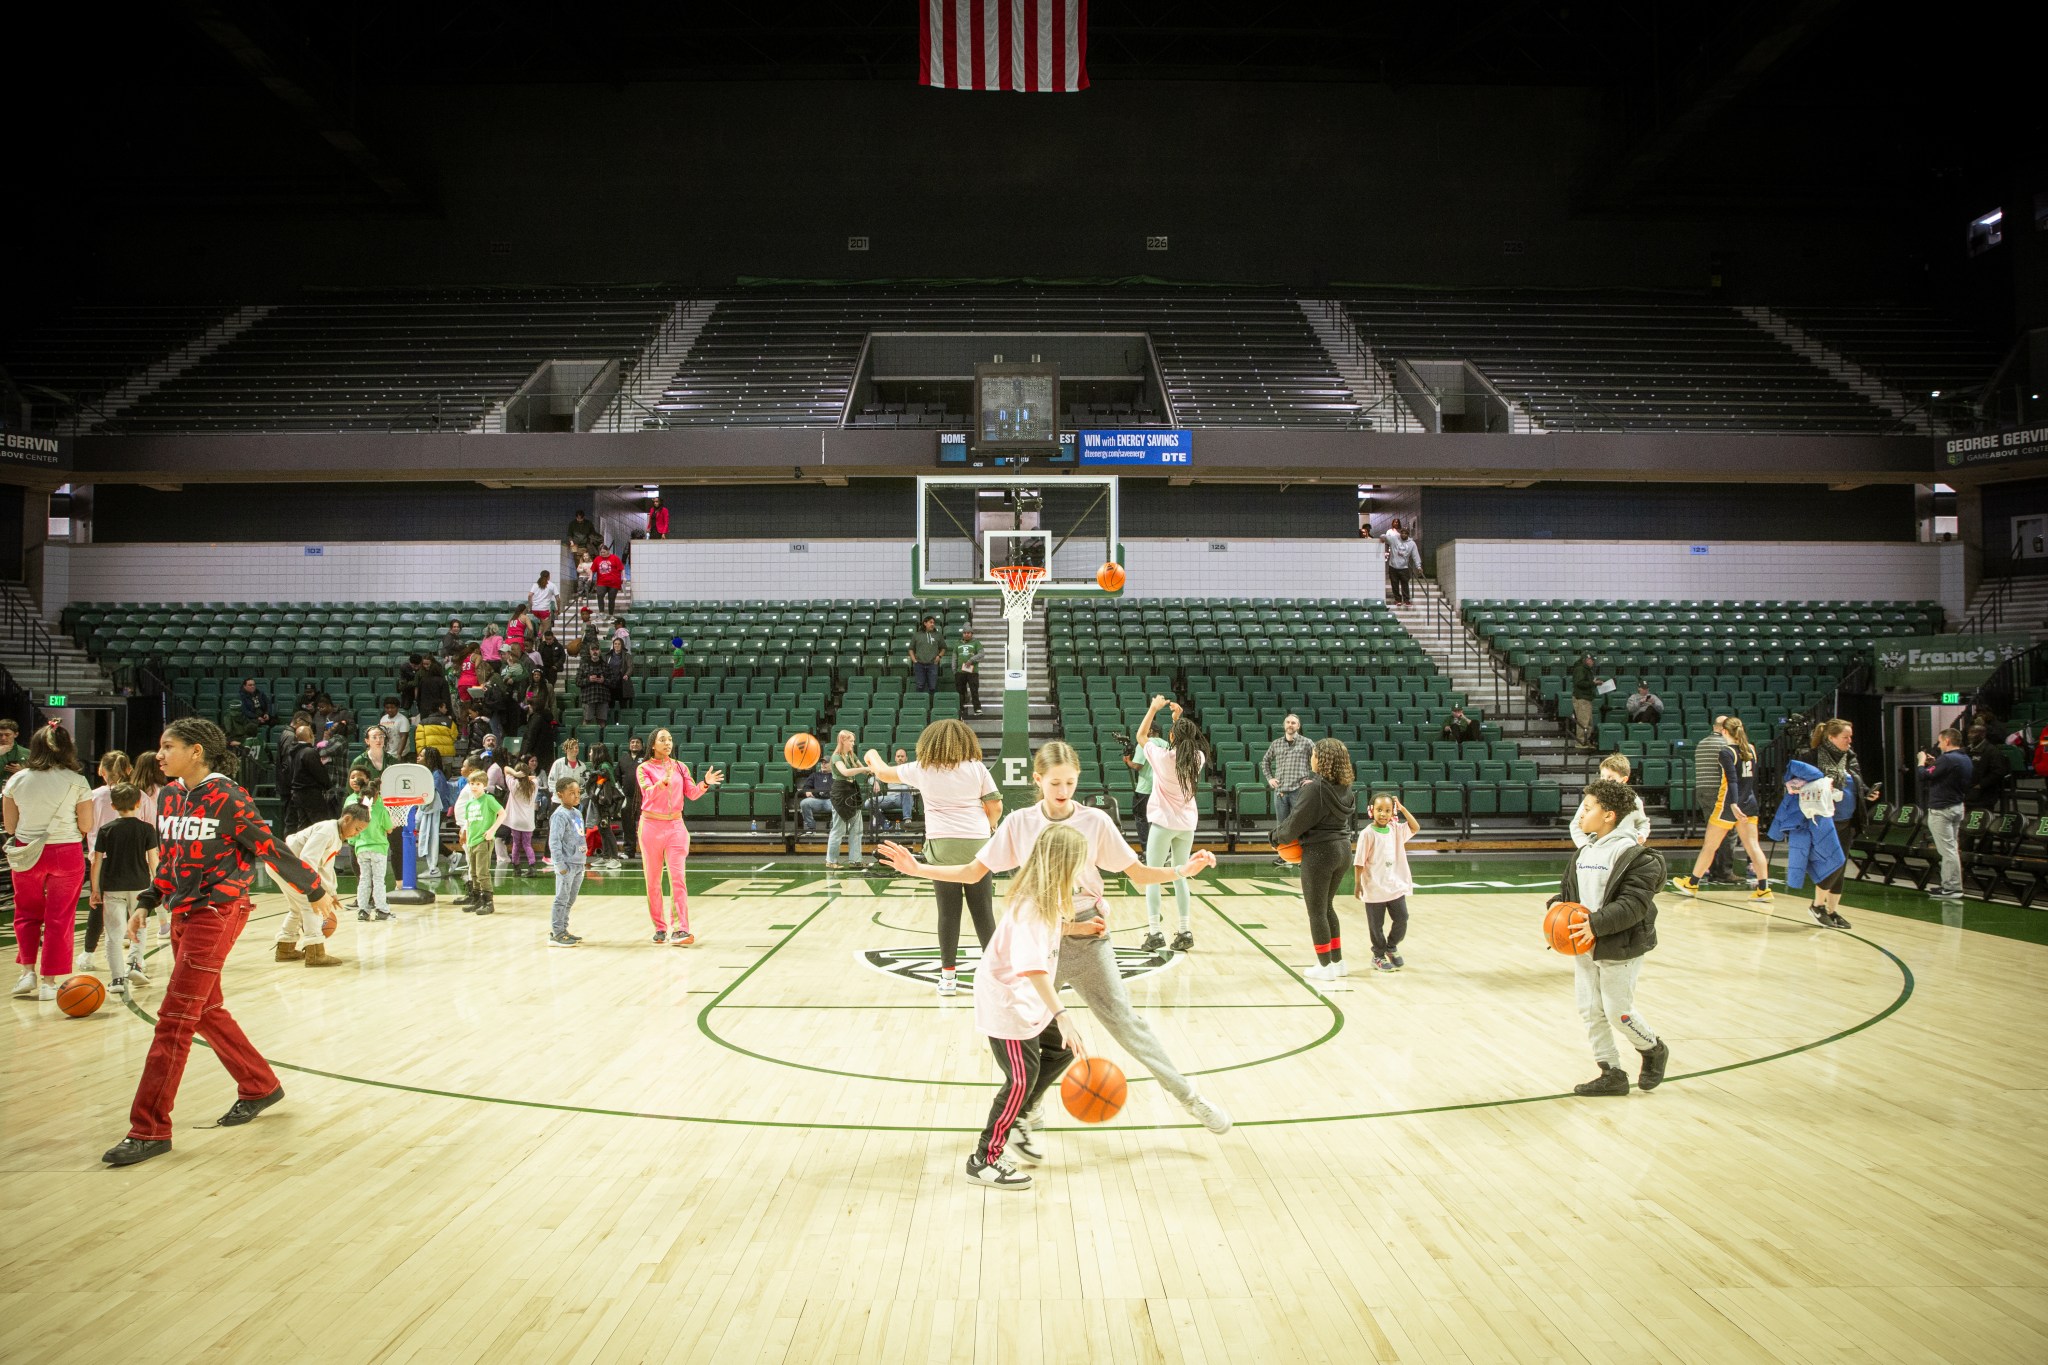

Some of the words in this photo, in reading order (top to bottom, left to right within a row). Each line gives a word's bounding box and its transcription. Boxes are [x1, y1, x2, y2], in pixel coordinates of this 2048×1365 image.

[850, 238, 867, 248] 201
[1148, 238, 1167, 248] 226
[7, 434, 58, 453] GERVIN
[941, 433, 966, 444] HOME
[1084, 434, 1100, 447] WIN
[1101, 436, 1116, 447] with
[1117, 434, 1145, 447] ENERGY
[1147, 434, 1179, 447] SAVINGS
[1946, 434, 1999, 454] GEORGE
[25, 453, 58, 463] CENTER
[1162, 452, 1187, 462] DTE
[1966, 448, 2018, 461] GAMEABOVE
[1908, 646, 1996, 665] Frame's
[49, 695, 66, 706] EXIT
[1943, 693, 1959, 704] EXIT
[1002, 757, 1028, 786] E
[1742, 760, 1753, 778] 12
[402, 779, 411, 790] E
[1873, 804, 1888, 821] E
[1898, 806, 1914, 823] E
[1967, 811, 1984, 830] E
[2000, 814, 2017, 832] E
